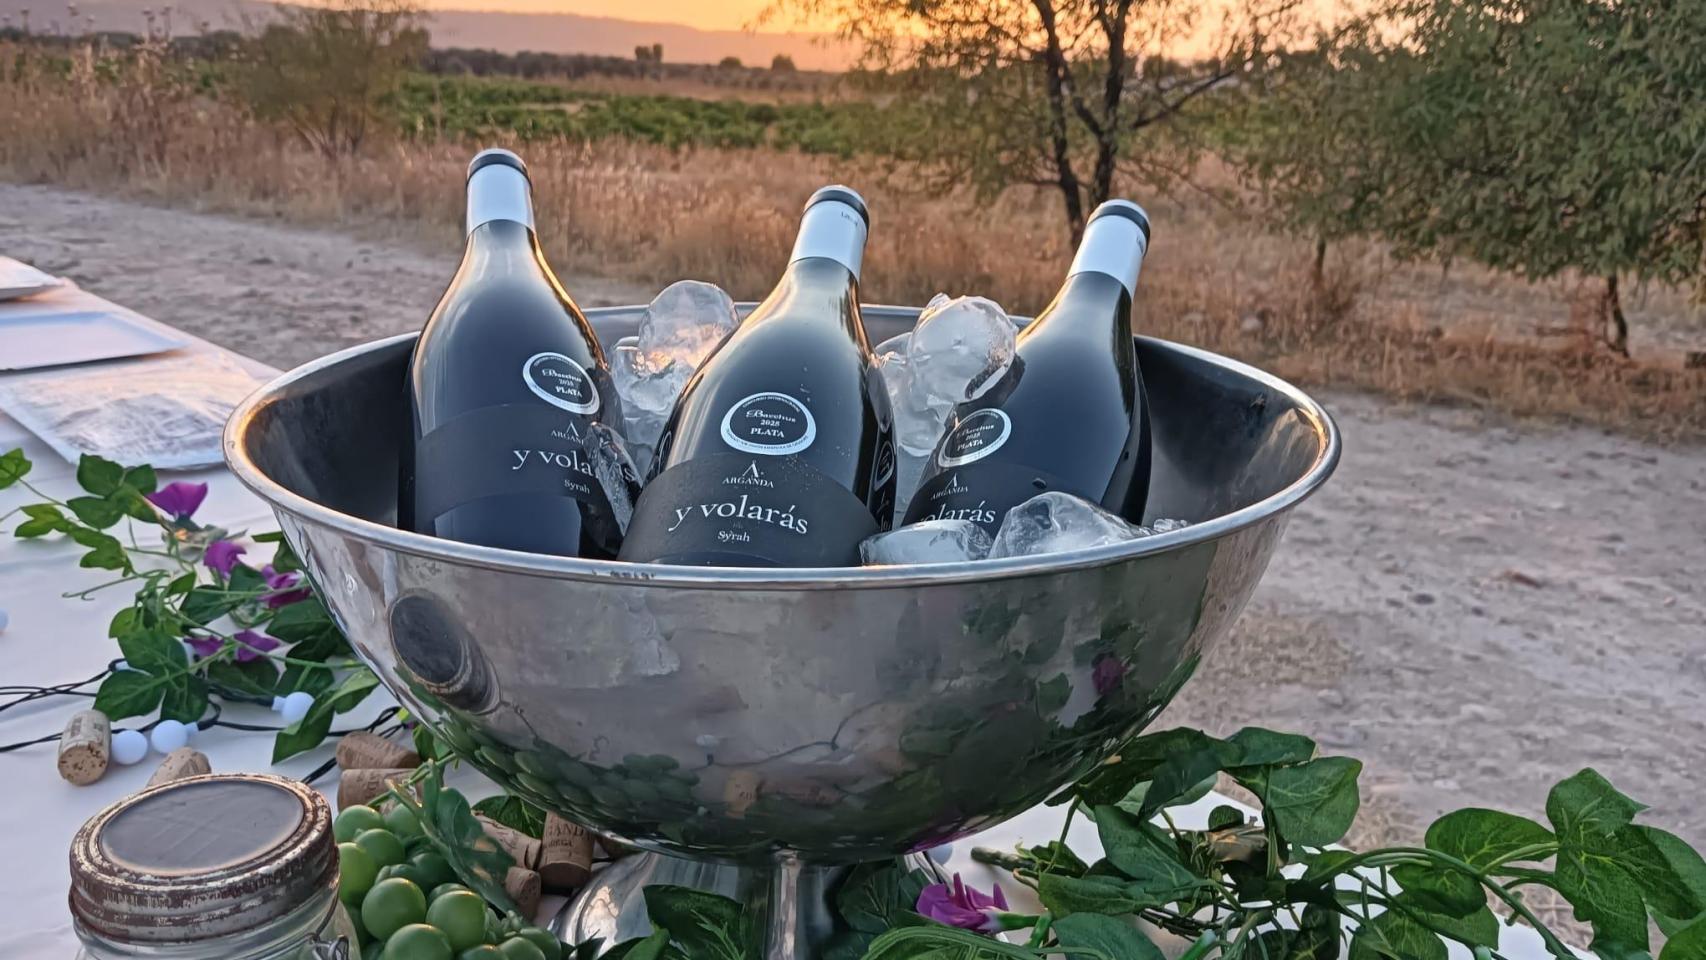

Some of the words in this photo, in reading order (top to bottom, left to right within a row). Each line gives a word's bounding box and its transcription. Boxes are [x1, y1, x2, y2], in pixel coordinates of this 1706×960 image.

[555, 386, 583, 398] PLATA
[745, 409, 797, 423] Bacchus
[551, 430, 584, 445] ARGAN
[750, 427, 785, 438] PLATA
[957, 439, 983, 452] PLATA
[512, 449, 531, 470] y
[564, 480, 590, 494] Syrah
[722, 476, 774, 489] ARGANDA
[668, 506, 693, 532] y
[700, 494, 808, 534] volarás
[920, 500, 996, 523] olarás
[717, 530, 751, 543] Syrah
